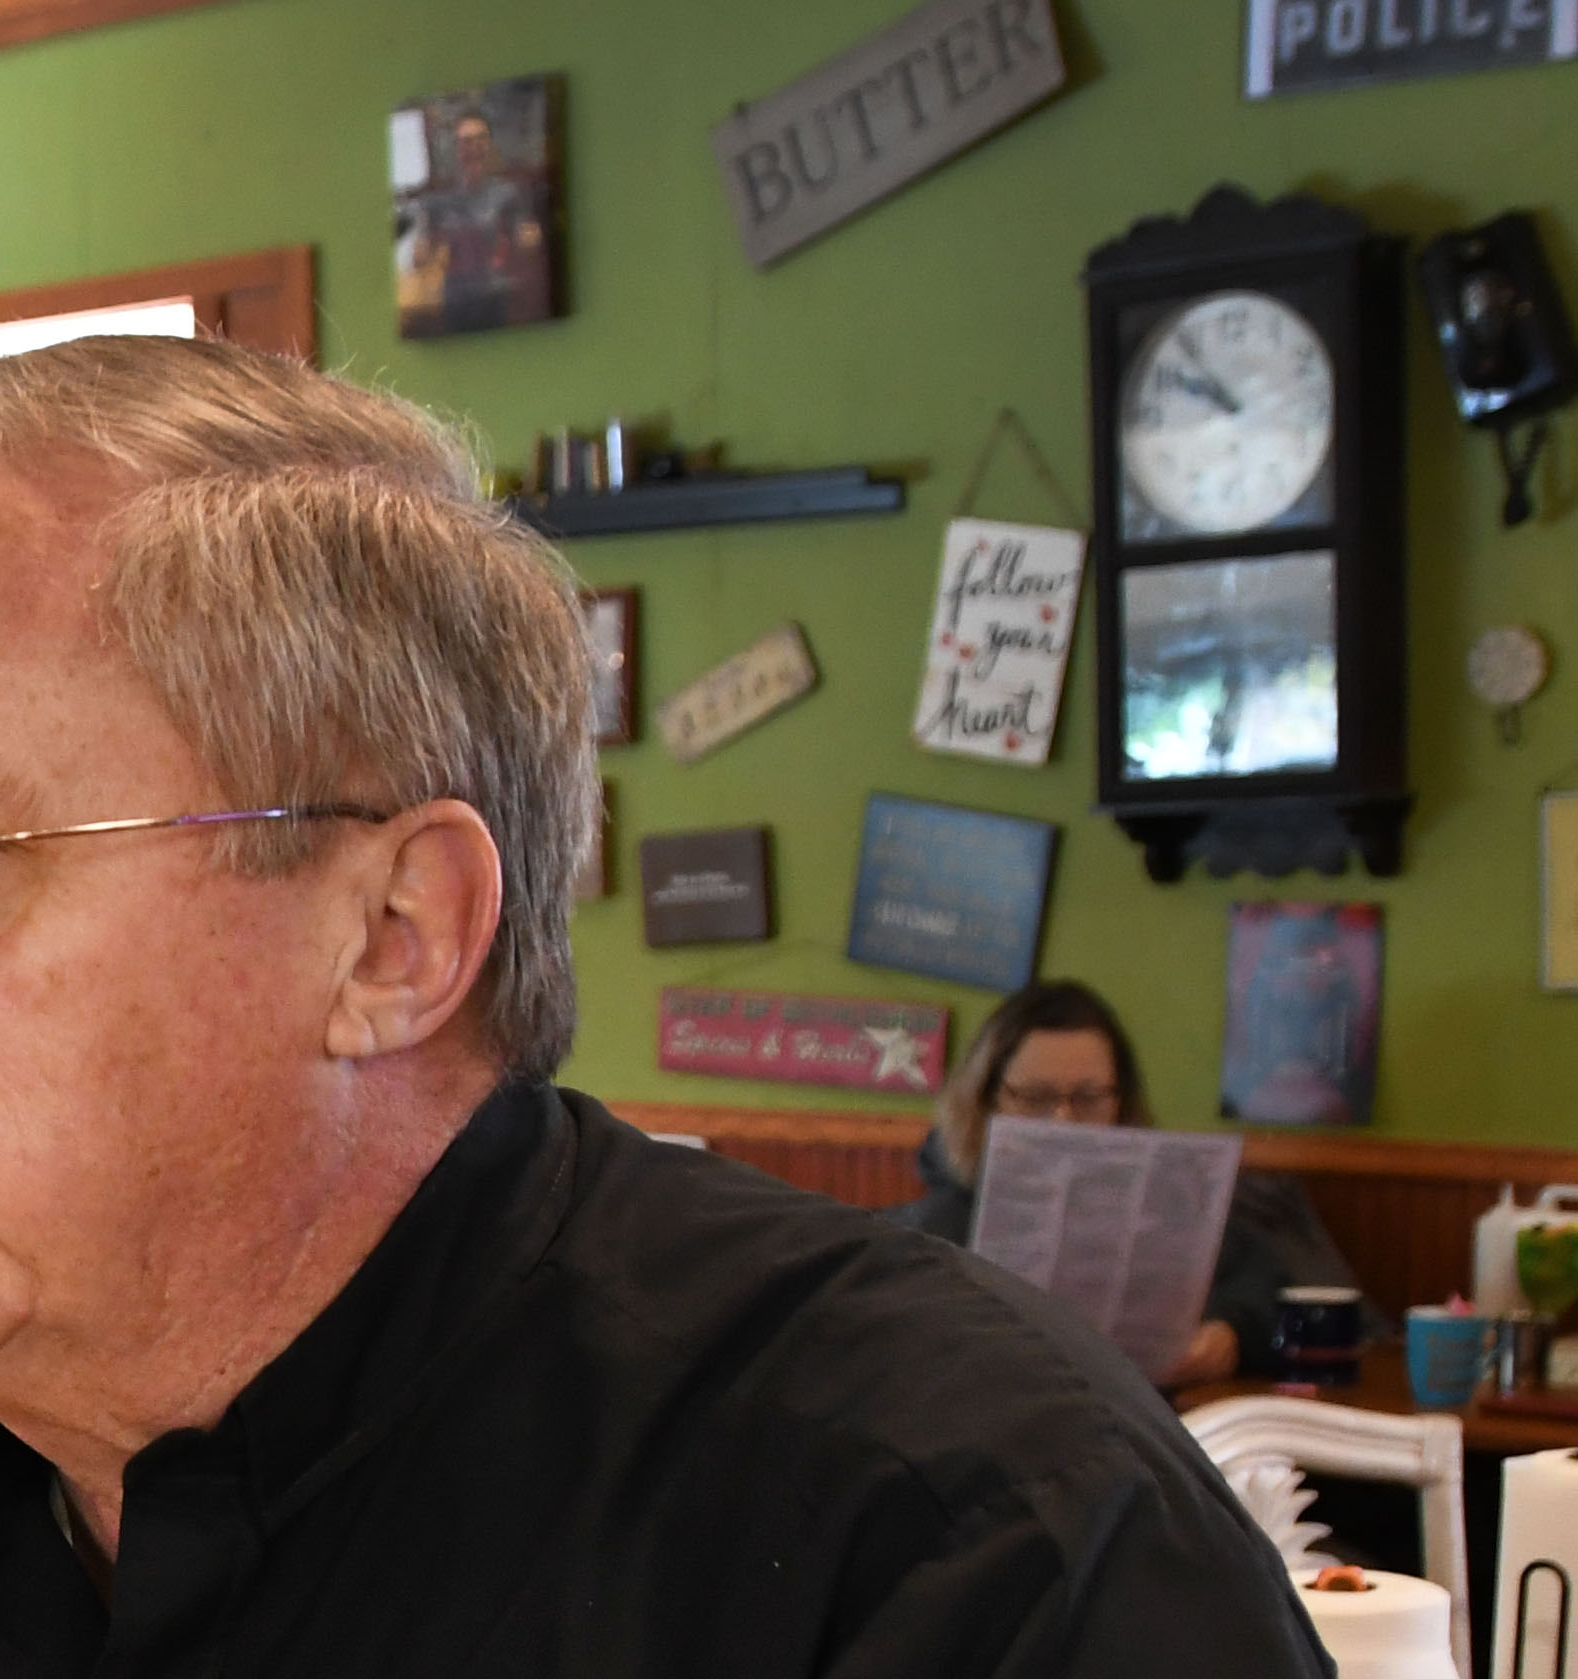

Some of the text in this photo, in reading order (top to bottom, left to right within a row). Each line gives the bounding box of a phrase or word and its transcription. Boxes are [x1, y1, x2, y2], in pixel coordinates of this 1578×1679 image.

[736, 0, 1040, 222] BUTTER
[949, 538, 1068, 632] follow
[974, 618, 1066, 682] your
[921, 664, 1047, 740] heart
